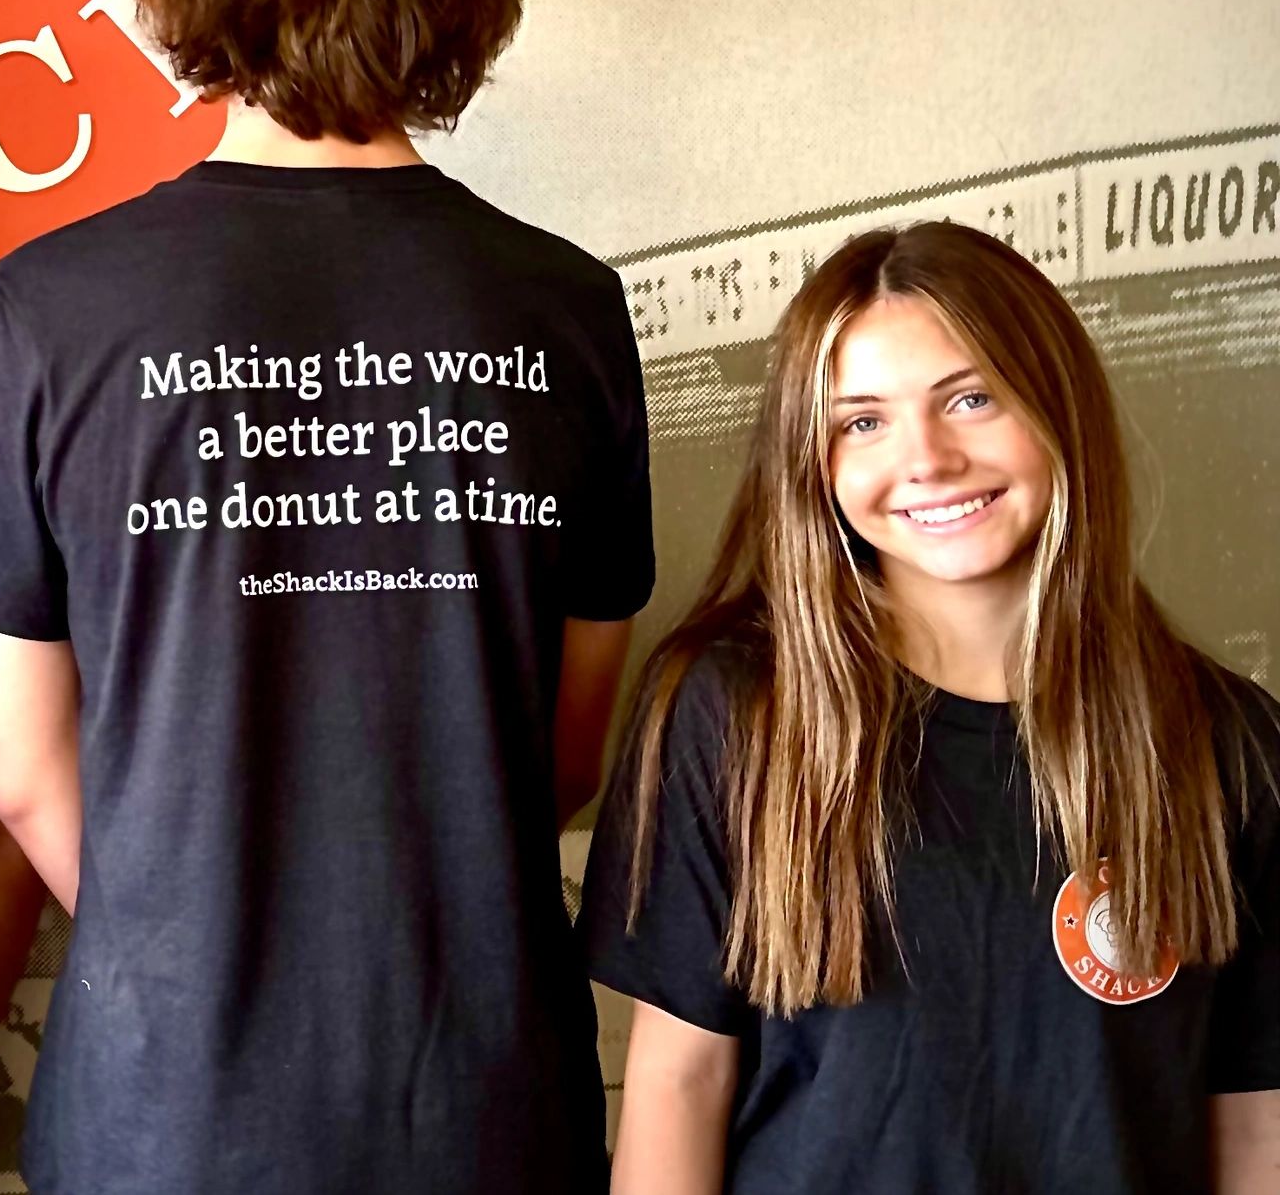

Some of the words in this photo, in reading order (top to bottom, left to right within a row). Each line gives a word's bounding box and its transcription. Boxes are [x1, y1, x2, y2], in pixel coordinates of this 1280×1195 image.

[1106, 161, 1280, 253] LIQUOR
[139, 344, 323, 401] Making
[334, 340, 413, 388] the
[424, 345, 550, 393] world
[198, 427, 224, 461] a
[233, 411, 374, 459] better
[386, 405, 509, 467] place
[127, 496, 208, 535] one
[221, 481, 362, 529] donut
[375, 481, 421, 524] at
[434, 488, 462, 522] a
[465, 477, 562, 527] time.
[238, 567, 479, 596] theShackIsBack.com
